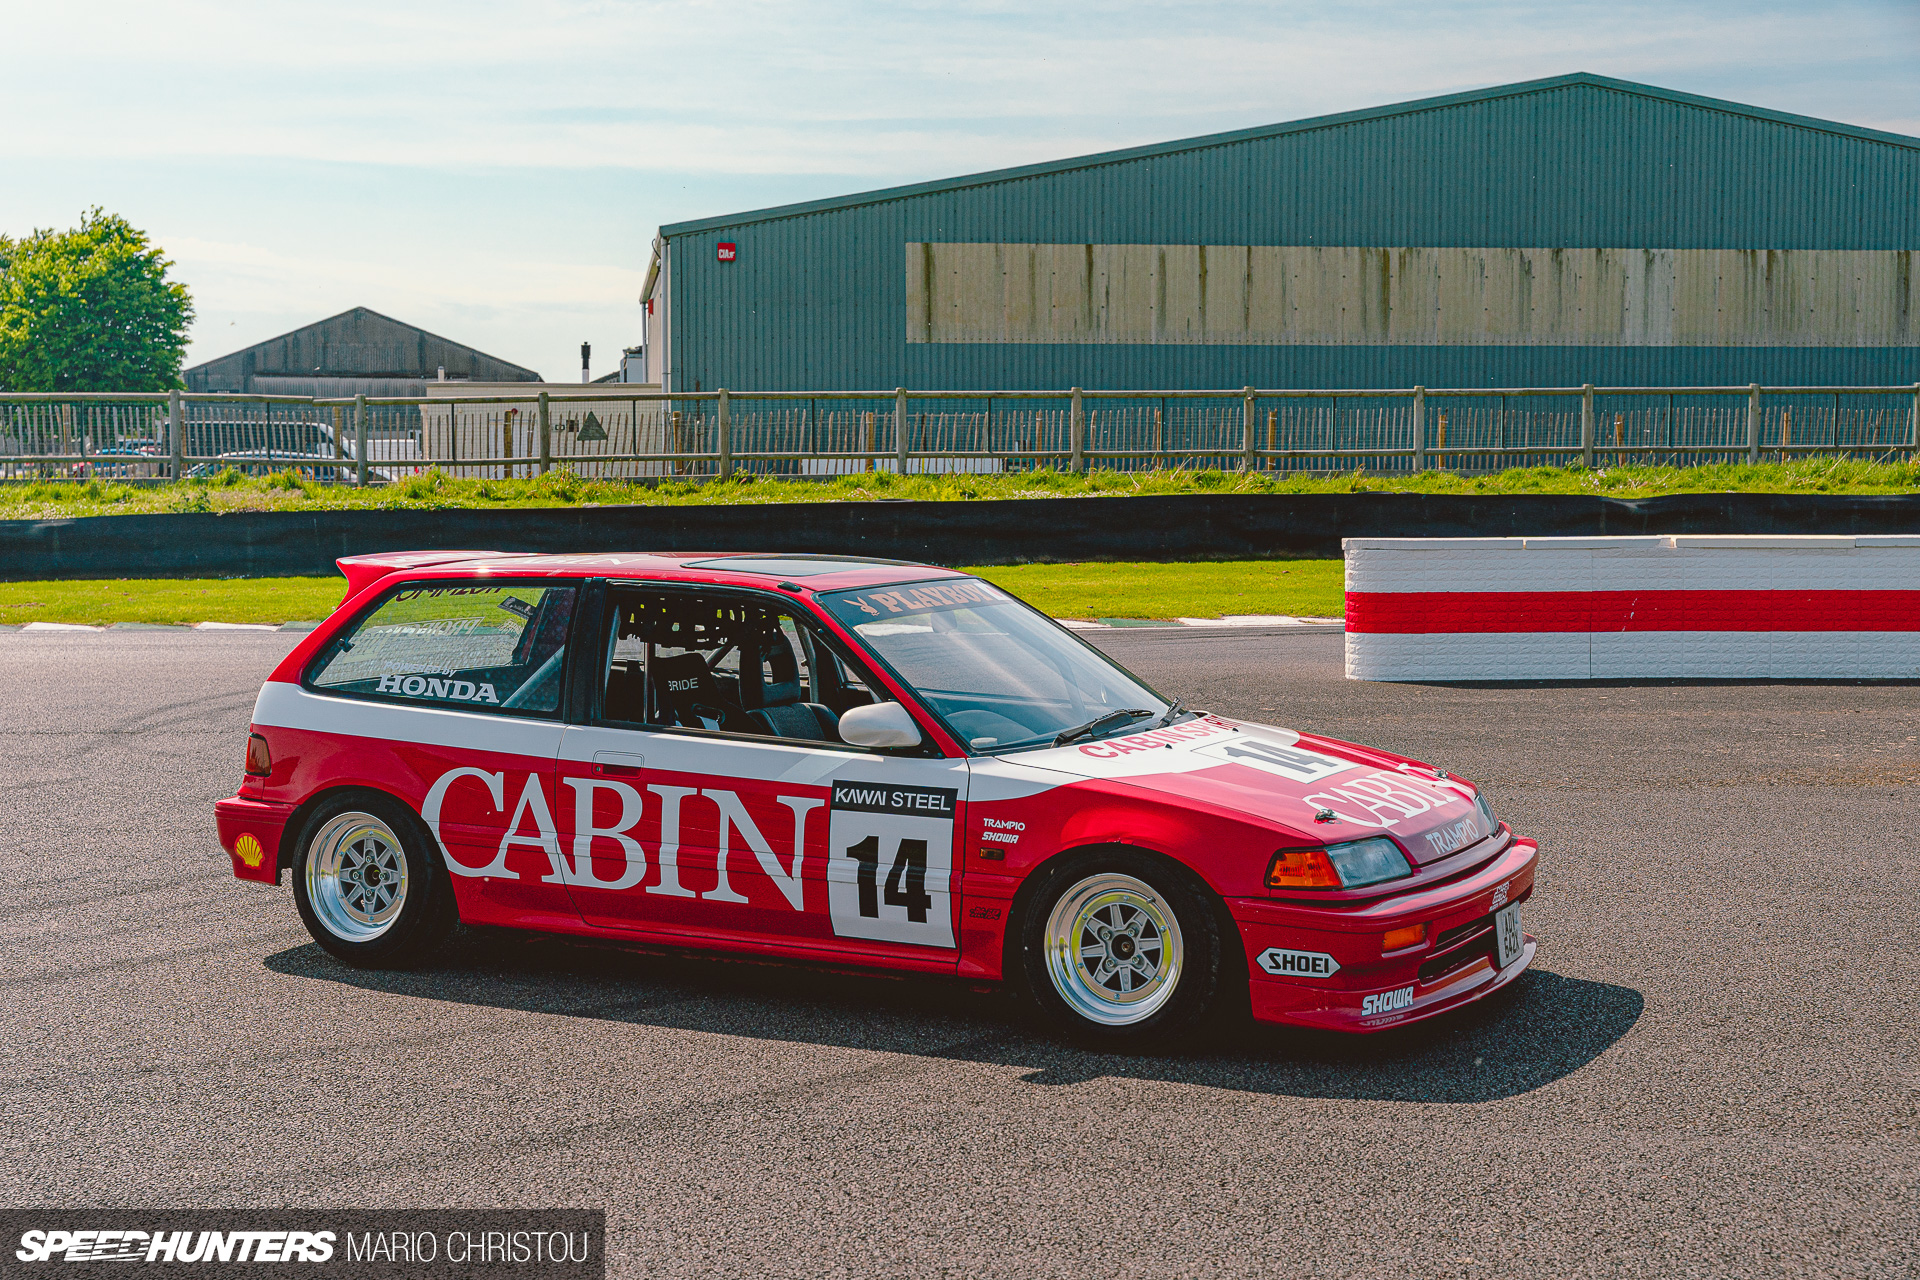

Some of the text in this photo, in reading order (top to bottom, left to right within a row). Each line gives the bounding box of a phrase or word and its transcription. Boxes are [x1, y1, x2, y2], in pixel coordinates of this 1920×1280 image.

[868, 584, 993, 613] PLAYBOY
[383, 661, 457, 678] POWERED by
[376, 674, 500, 704] HONDA
[1223, 740, 1338, 774] 14
[835, 787, 951, 811] KAWAI STEEL
[421, 766, 826, 911] CABIN
[982, 831, 1019, 844] SHOWA
[983, 818, 1025, 831] TRAMPIO
[1425, 818, 1479, 855] TRAMPIO
[846, 835, 932, 924] 14
[1268, 953, 1330, 973] SHOEI
[1361, 986, 1414, 1016] SHOWA
